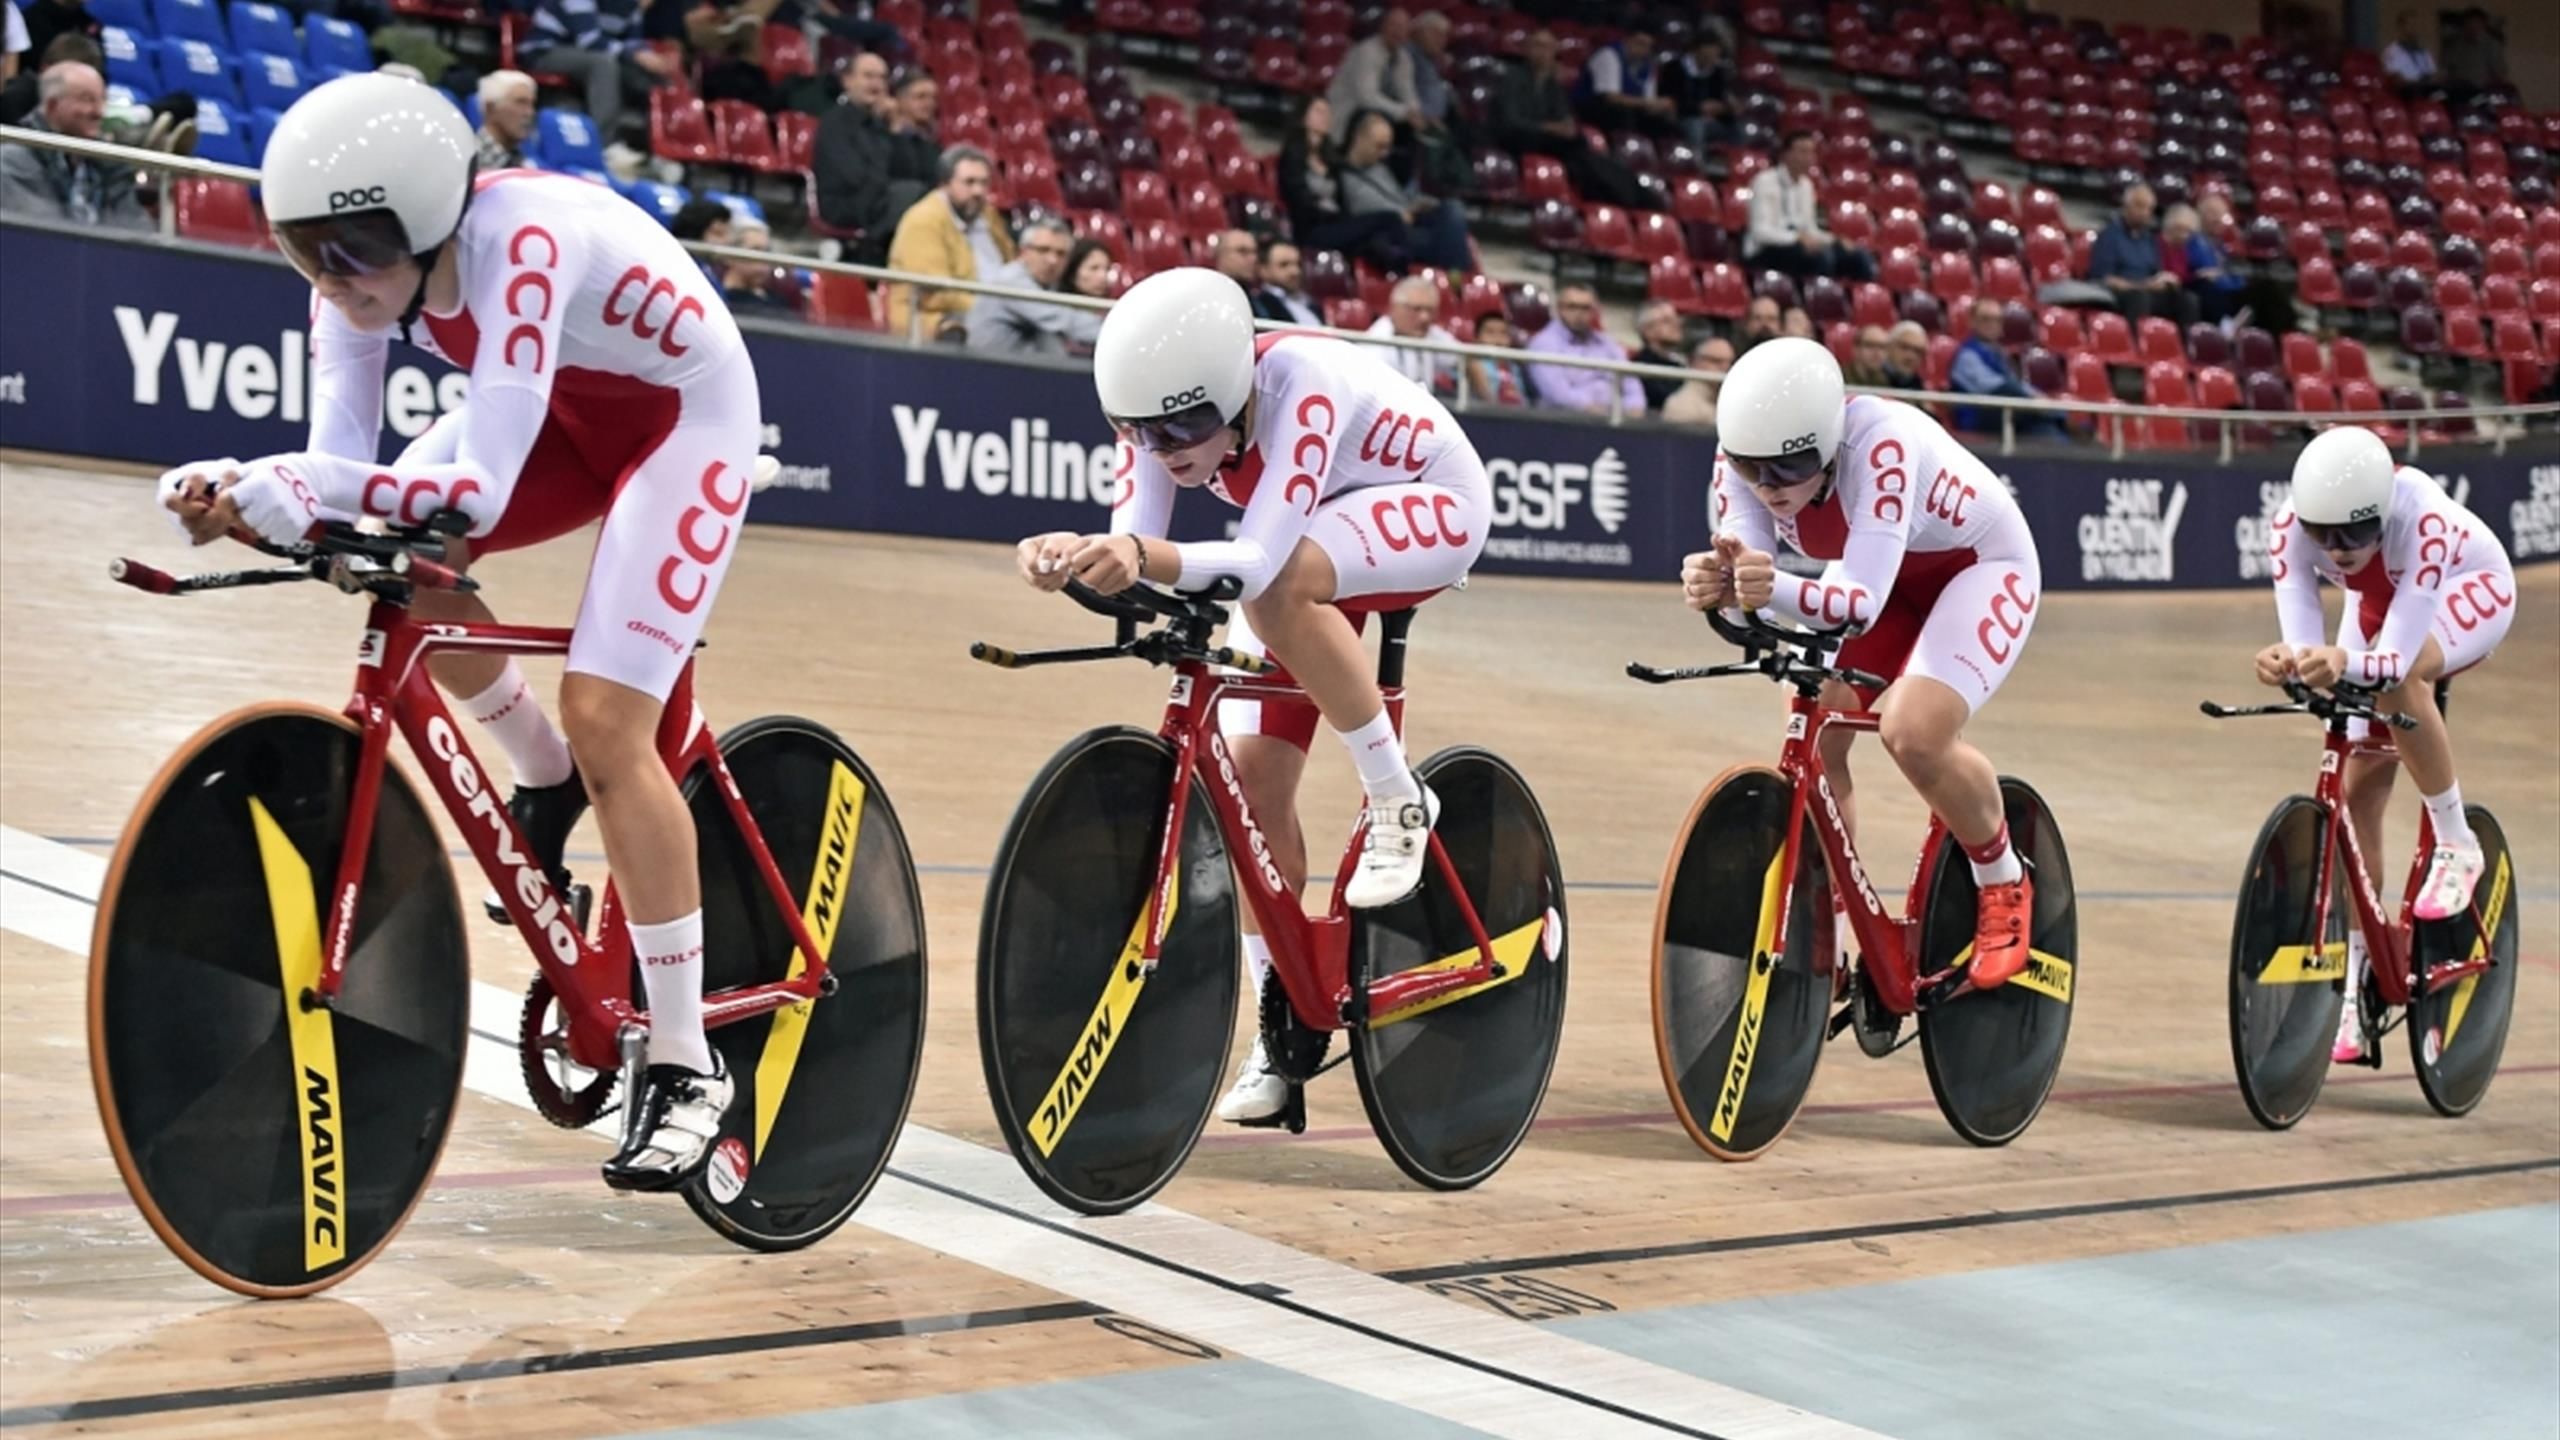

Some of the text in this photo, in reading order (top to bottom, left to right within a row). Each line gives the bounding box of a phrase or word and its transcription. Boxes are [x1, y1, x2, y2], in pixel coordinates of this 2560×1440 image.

[505, 225, 558, 374] CCC
[602, 265, 704, 357] CCC
[113, 306, 470, 438] Yveles
[891, 404, 1116, 506] Yveline
[1284, 394, 1336, 517] CCC
[1360, 407, 1435, 472] CCC
[1870, 439, 1905, 524] CCC
[274, 465, 318, 517] CCC
[362, 474, 481, 532] CCC
[1371, 494, 1469, 553] CCC
[1486, 458, 1589, 531] GSF
[1926, 467, 1977, 528] CCC
[658, 460, 748, 614] CCC
[2416, 512, 2448, 591] CCC
[1799, 580, 1869, 626] CCC
[1977, 572, 2036, 665] CCC
[2446, 573, 2512, 631] CCC
[813, 777, 855, 941] MAVIC
[1042, 1004, 1113, 1144] MAVIC
[1720, 1001, 1760, 1131] MAVIC
[305, 1066, 338, 1250] MAVIC
[1425, 1274, 1618, 1321] 250
